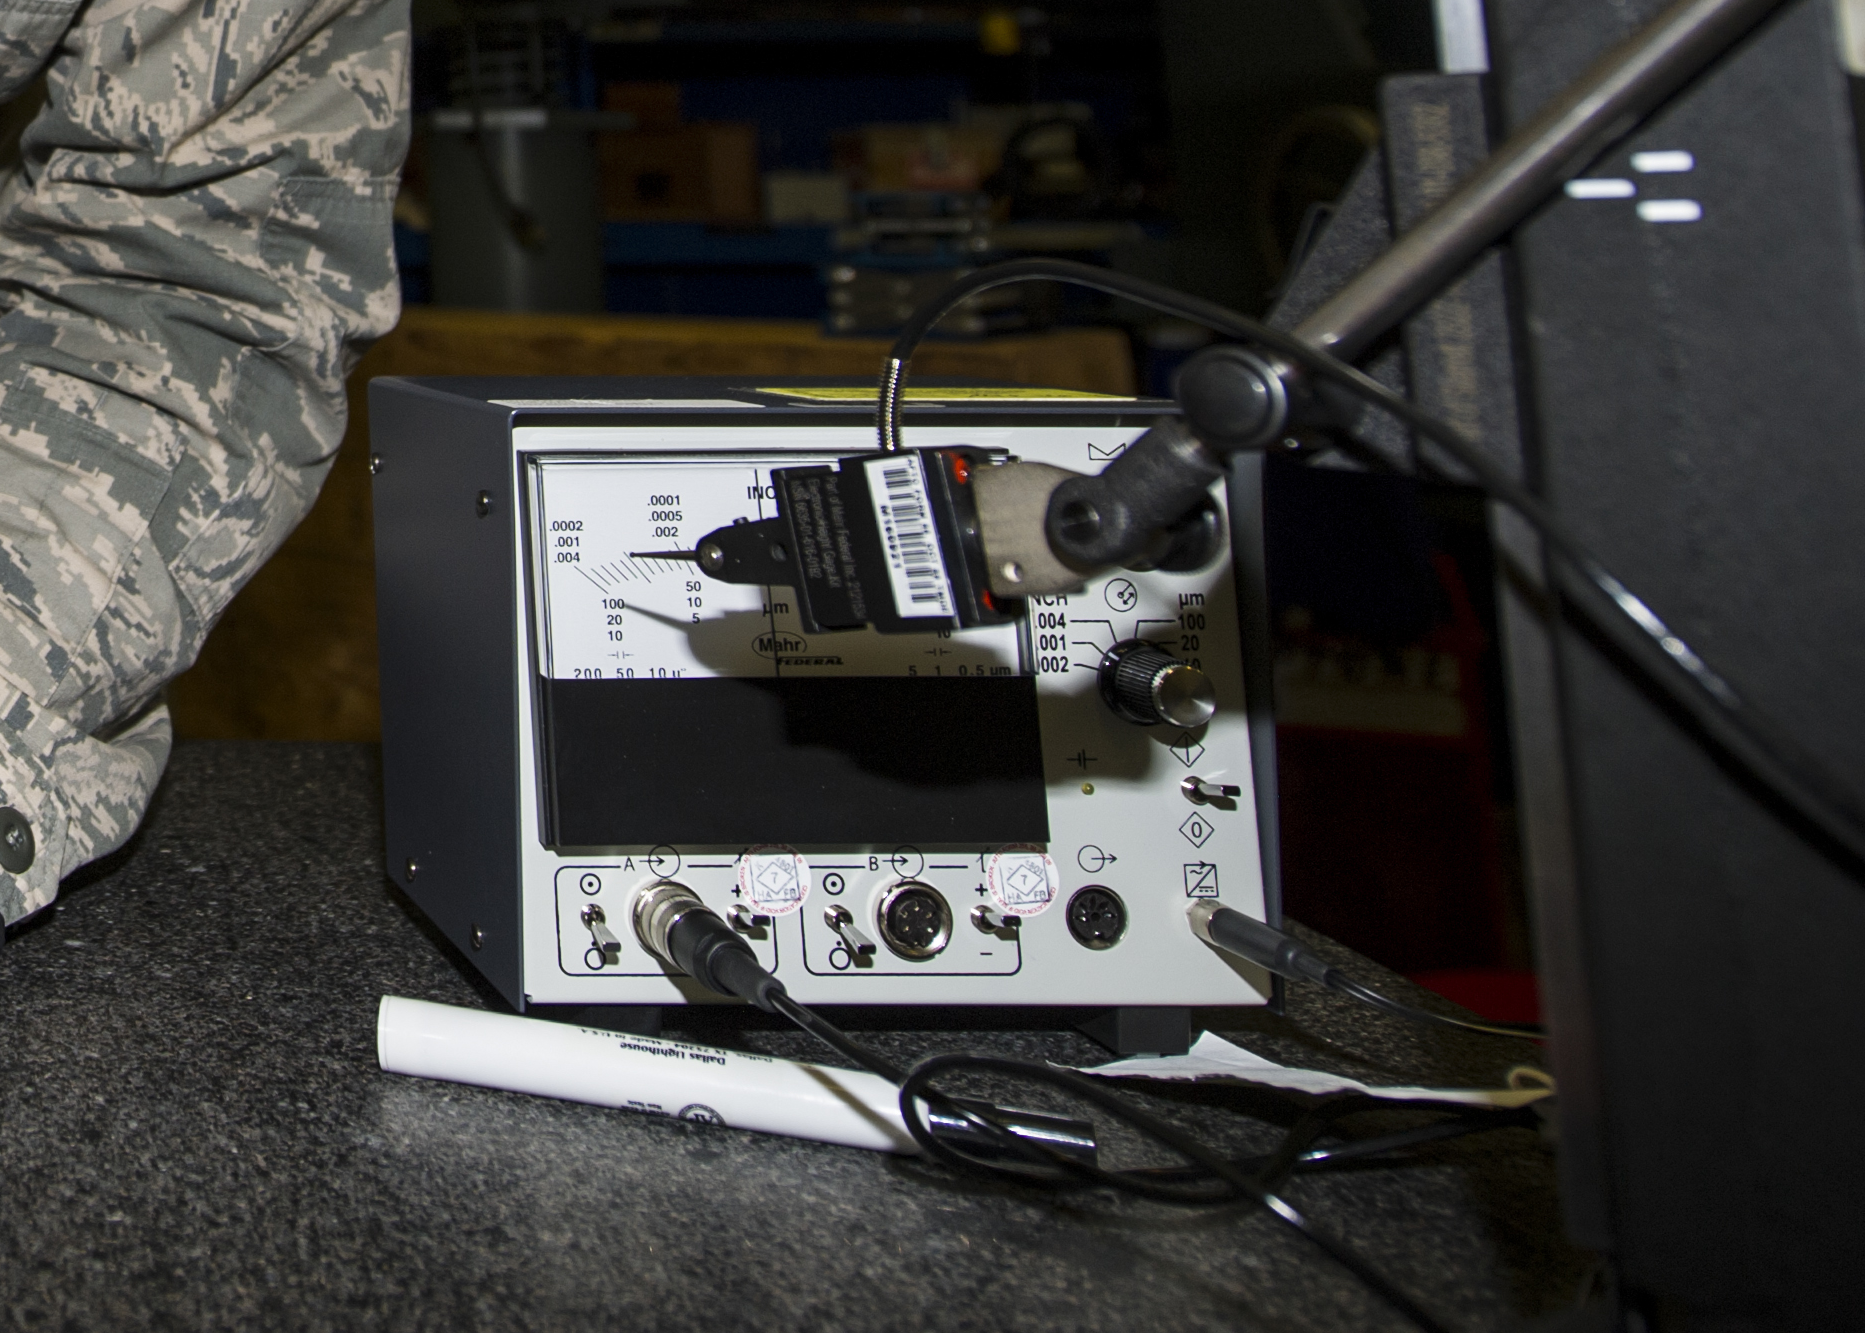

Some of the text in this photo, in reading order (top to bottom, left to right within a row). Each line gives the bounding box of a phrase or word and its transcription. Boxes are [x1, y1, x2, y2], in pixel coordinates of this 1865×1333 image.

[747, 485, 775, 499] INC
[647, 494, 681, 506] .0001
[648, 510, 683, 522] .0005
[549, 520, 584, 532] .0002
[651, 526, 679, 537] .002
[554, 536, 580, 548] .001
[553, 552, 580, 563] .004
[686, 580, 701, 592] 50
[601, 598, 625, 610] 100
[687, 596, 702, 608] 10
[607, 614, 622, 626] 20
[692, 612, 701, 624] 5
[1178, 613, 1206, 630] 100
[607, 630, 623, 642] 10
[758, 637, 801, 652] Mahr
[1181, 634, 1200, 651] 20
[776, 655, 844, 666] FEDERAL
[908, 664, 918, 676] 5
[623, 857, 635, 871] A
[869, 856, 879, 871] B
[770, 871, 779, 884] 7
[1020, 873, 1028, 886] 7
[619, 1040, 727, 1067] Dallas Lighthouse
